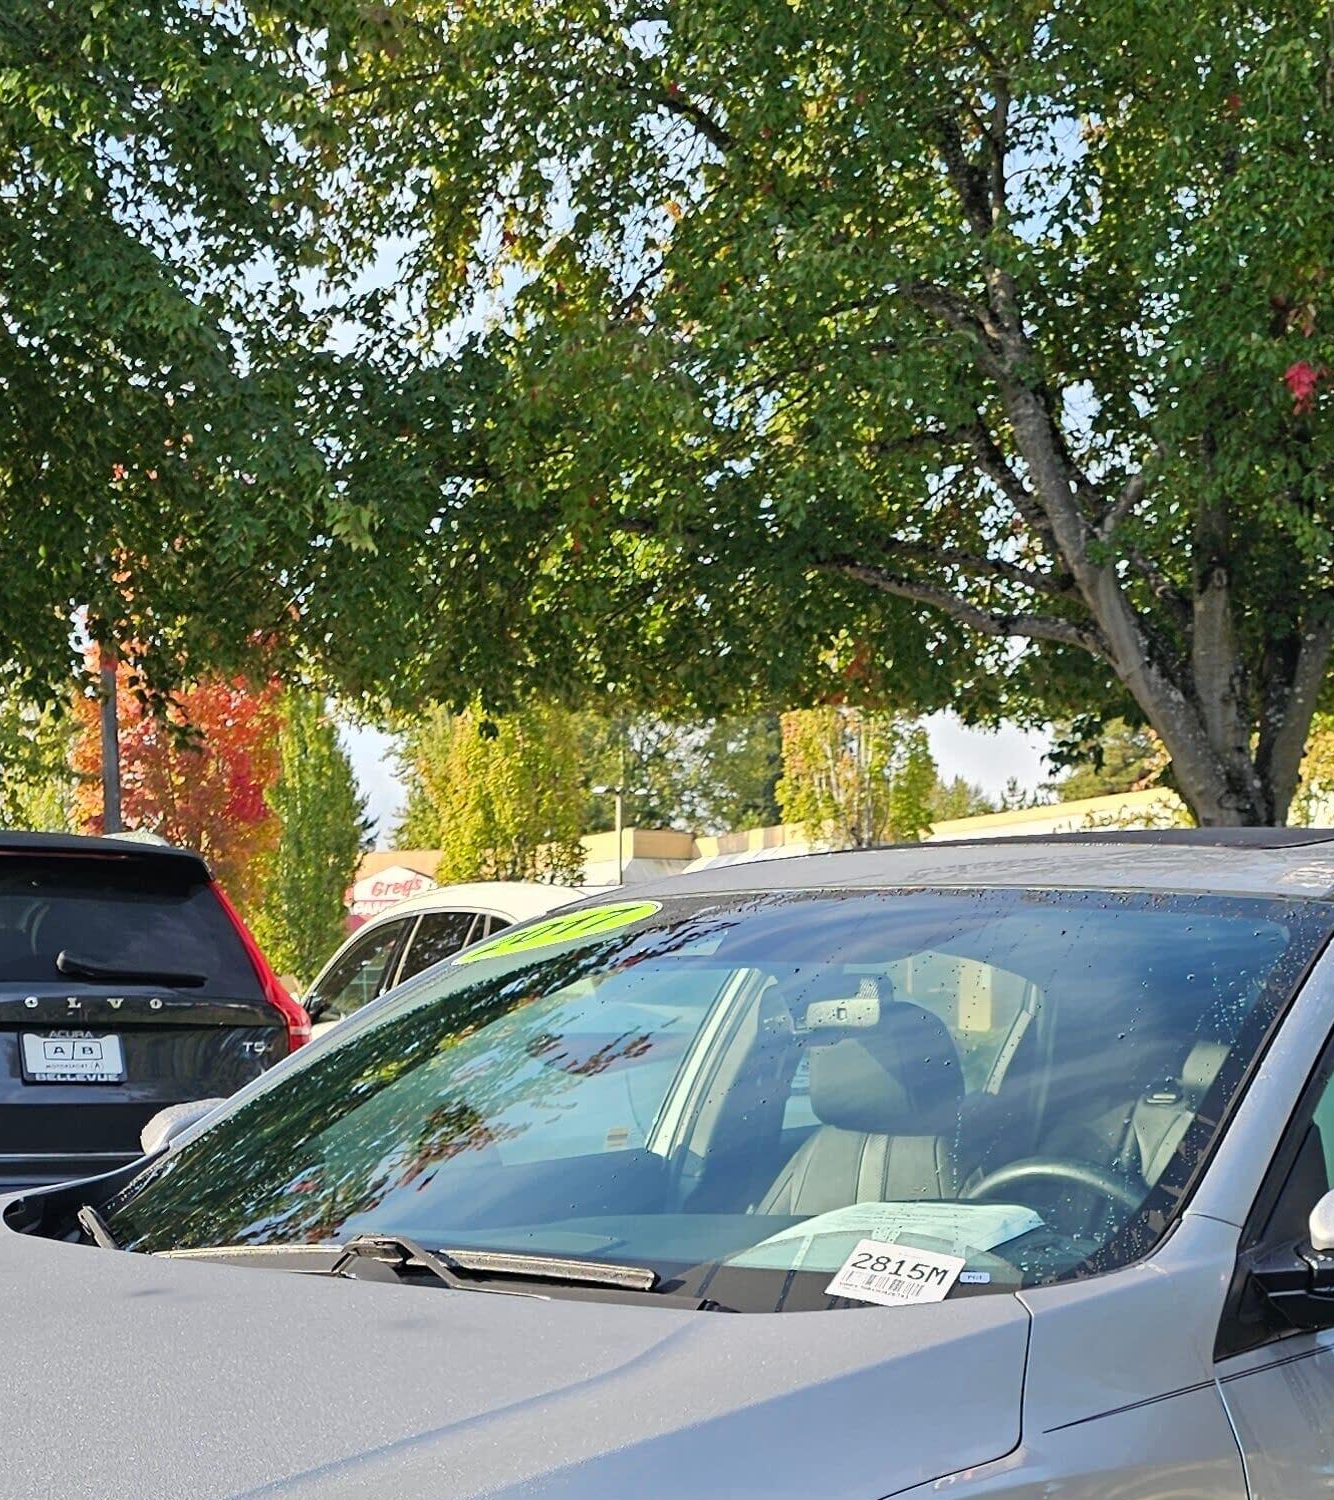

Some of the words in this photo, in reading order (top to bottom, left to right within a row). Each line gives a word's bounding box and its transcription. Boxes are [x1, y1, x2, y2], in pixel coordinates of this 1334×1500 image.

[49, 1030, 94, 1038] ACURA
[35, 1073, 120, 1082] BELLEVUE
[851, 1252, 949, 1286] 2815M
